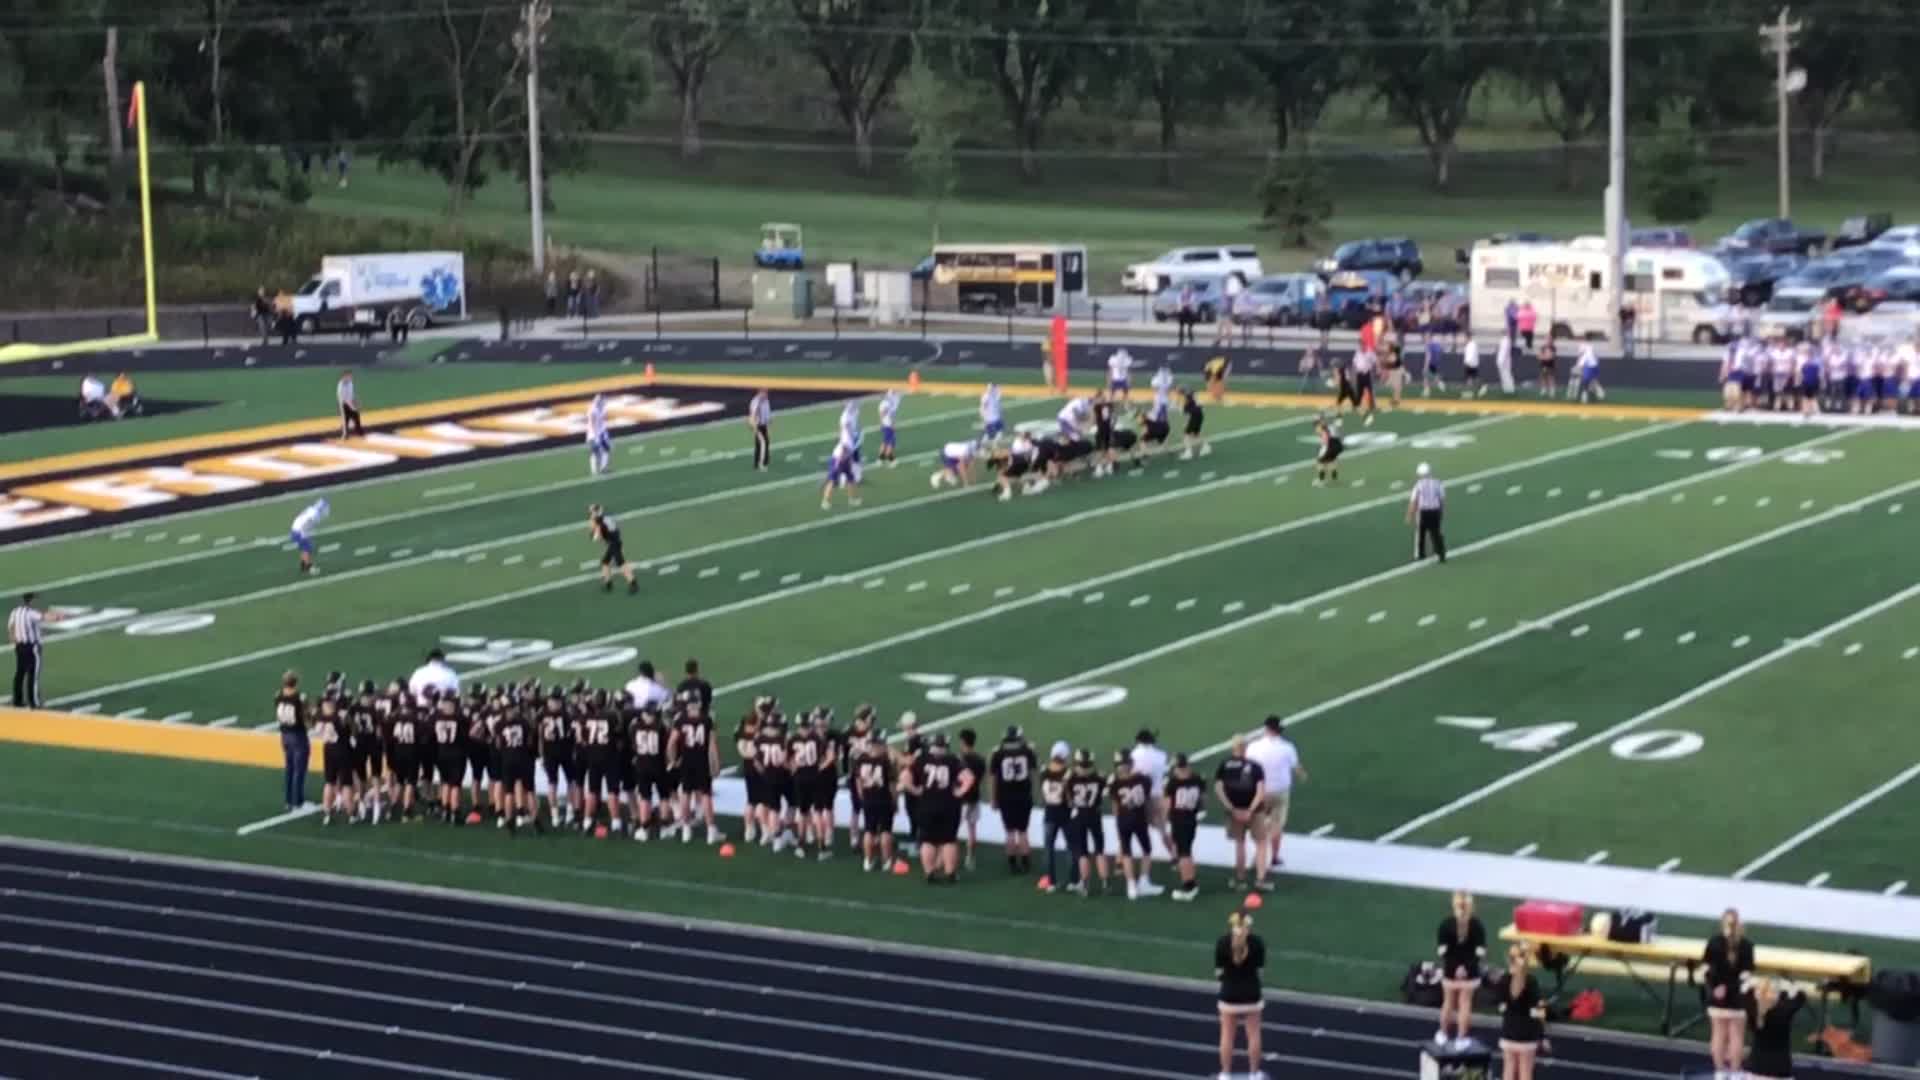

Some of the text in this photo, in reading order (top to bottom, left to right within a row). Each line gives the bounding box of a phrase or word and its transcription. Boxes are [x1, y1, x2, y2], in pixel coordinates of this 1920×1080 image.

[584, 719, 609, 744] 72
[1479, 720, 1705, 760] 40
[1000, 754, 1029, 782] 63
[1071, 781, 1100, 808] 27
